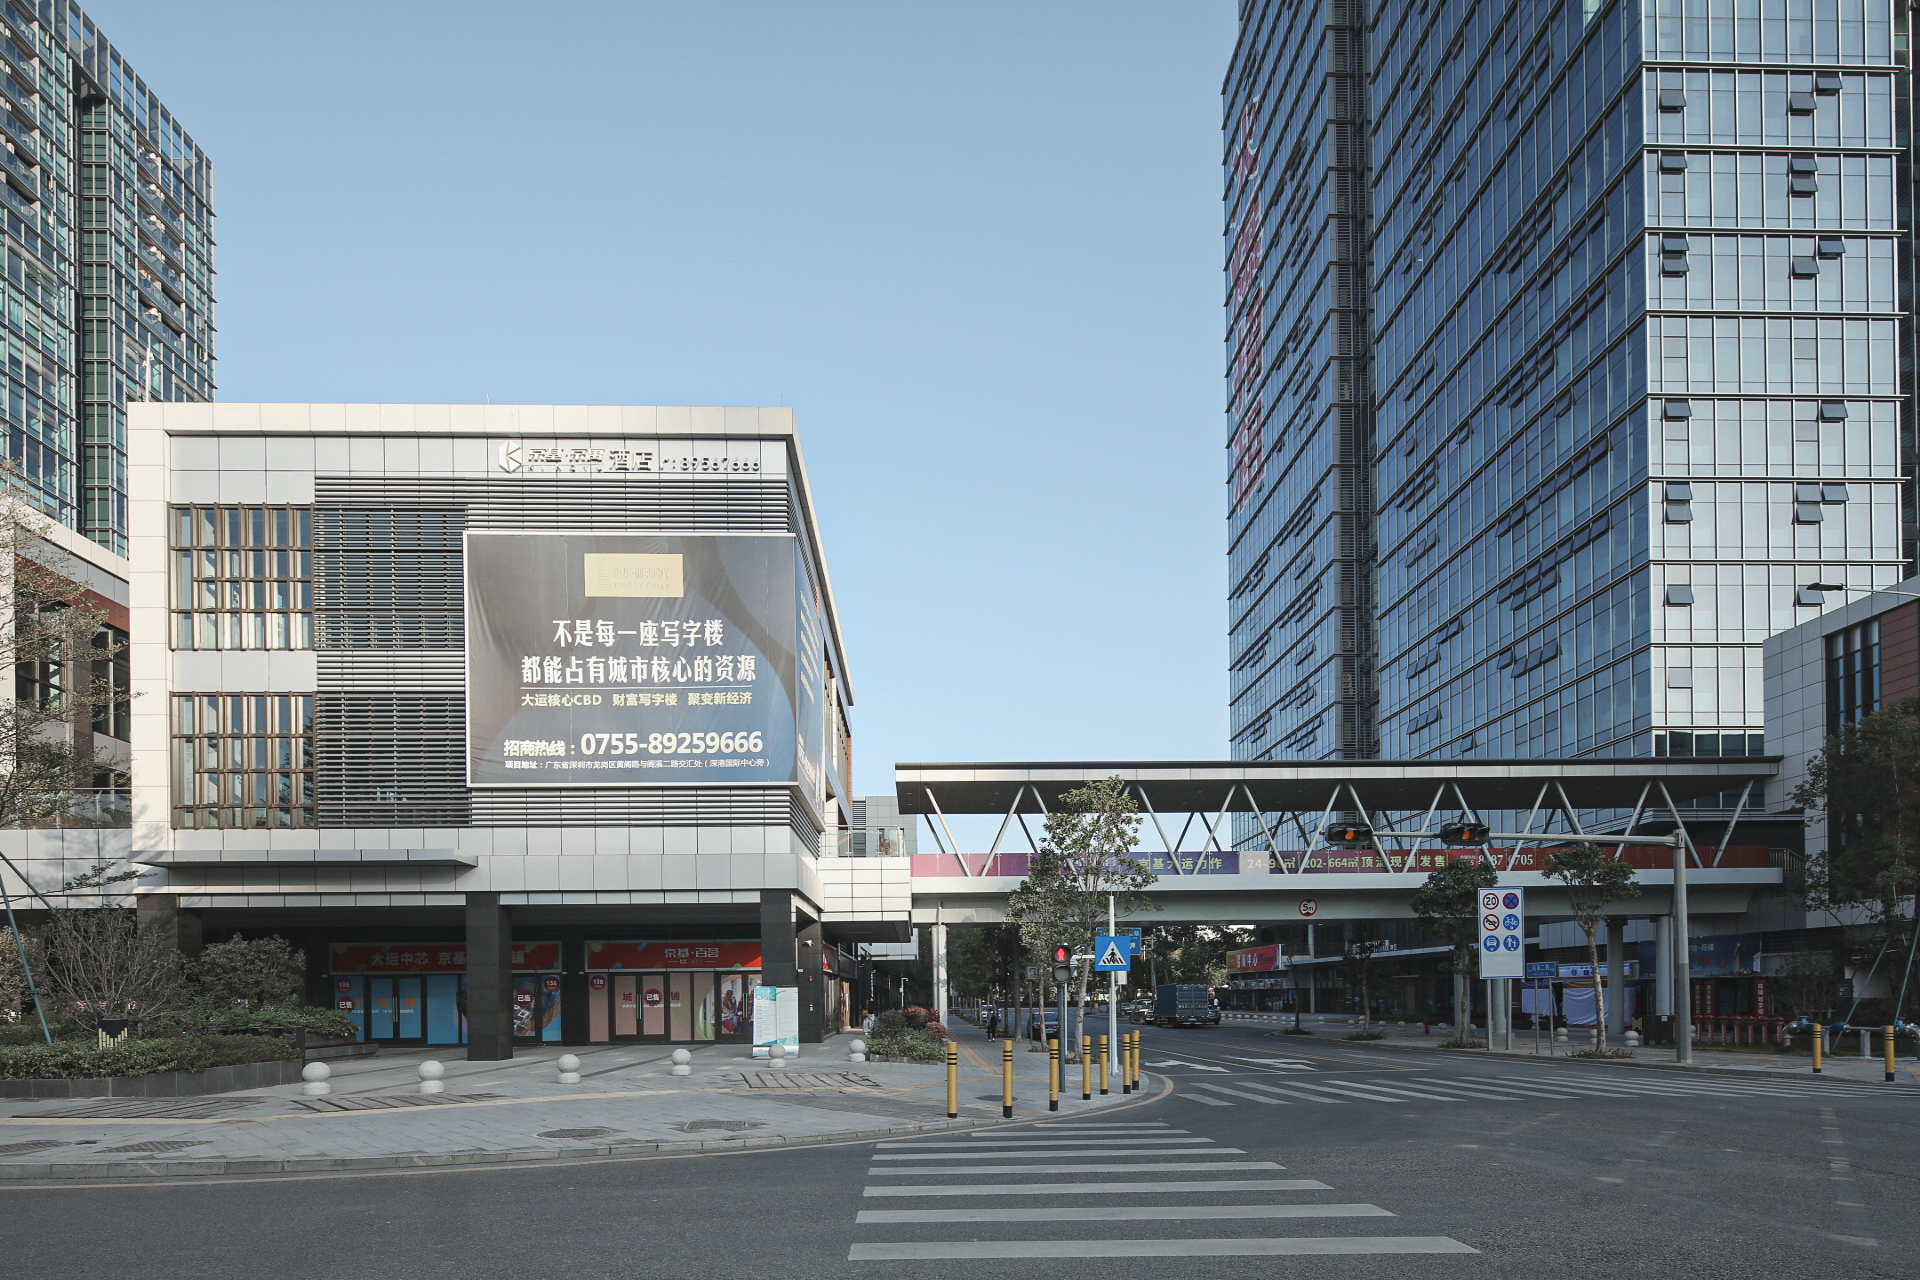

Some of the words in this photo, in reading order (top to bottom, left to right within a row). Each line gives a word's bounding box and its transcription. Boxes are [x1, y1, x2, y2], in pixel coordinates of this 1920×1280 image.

[552, 619, 724, 648] 不是每一座写字楼
[521, 655, 756, 684] 都能占有城市核心的资源
[521, 693, 602, 707] 大运核心CBD
[612, 693, 678, 707] 财富写字楼
[688, 692, 753, 706] 聚变新经济
[581, 731, 763, 756] 0755-89259666
[1302, 902, 1314, 912] 5m
[1485, 896, 1498, 906] 20
[371, 951, 428, 966] 大运中芯
